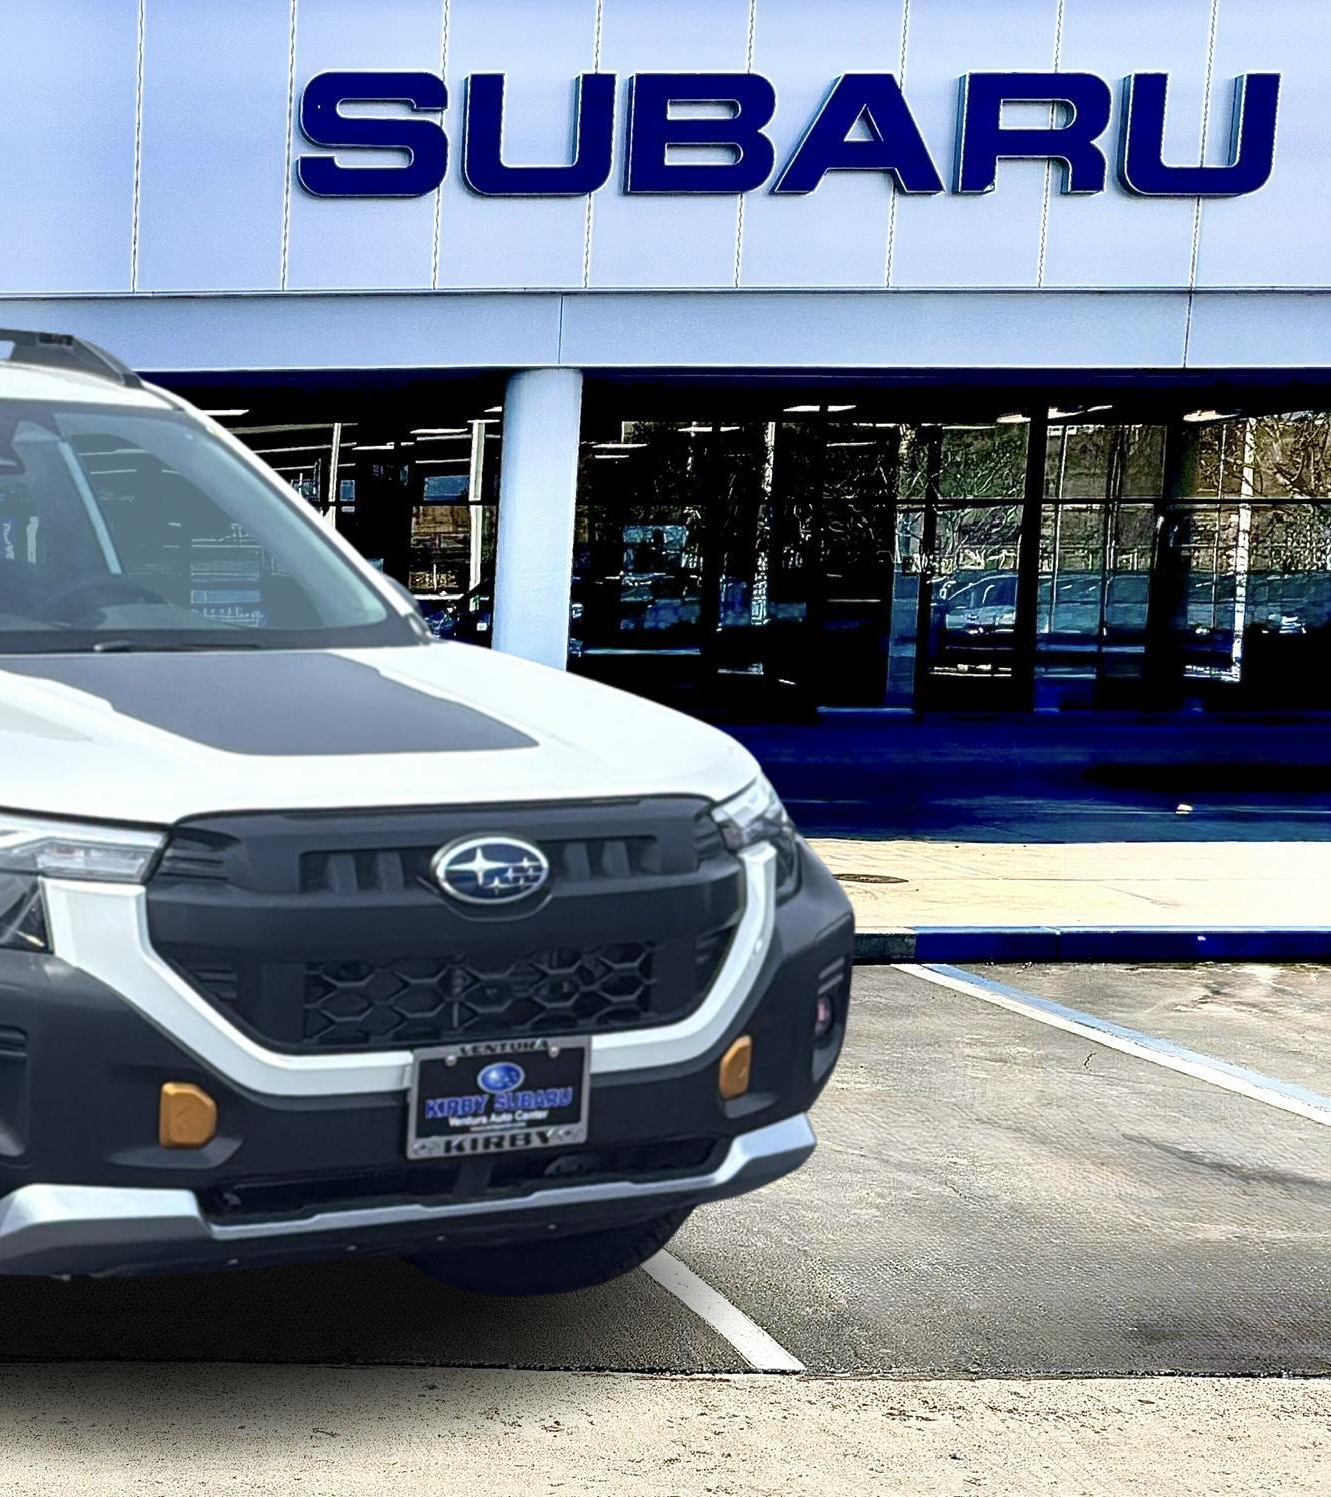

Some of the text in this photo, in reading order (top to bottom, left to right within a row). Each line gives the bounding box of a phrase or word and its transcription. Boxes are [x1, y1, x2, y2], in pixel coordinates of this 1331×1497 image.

[297, 71, 1282, 197] SUBARU
[460, 1040, 549, 1055] VENTURA
[426, 1087, 573, 1119] KIRBY SUBARU
[448, 1115, 488, 1127] Ventura
[490, 1112, 513, 1122] Auto
[515, 1110, 549, 1120] Center
[444, 1130, 553, 1153] KIRBY
